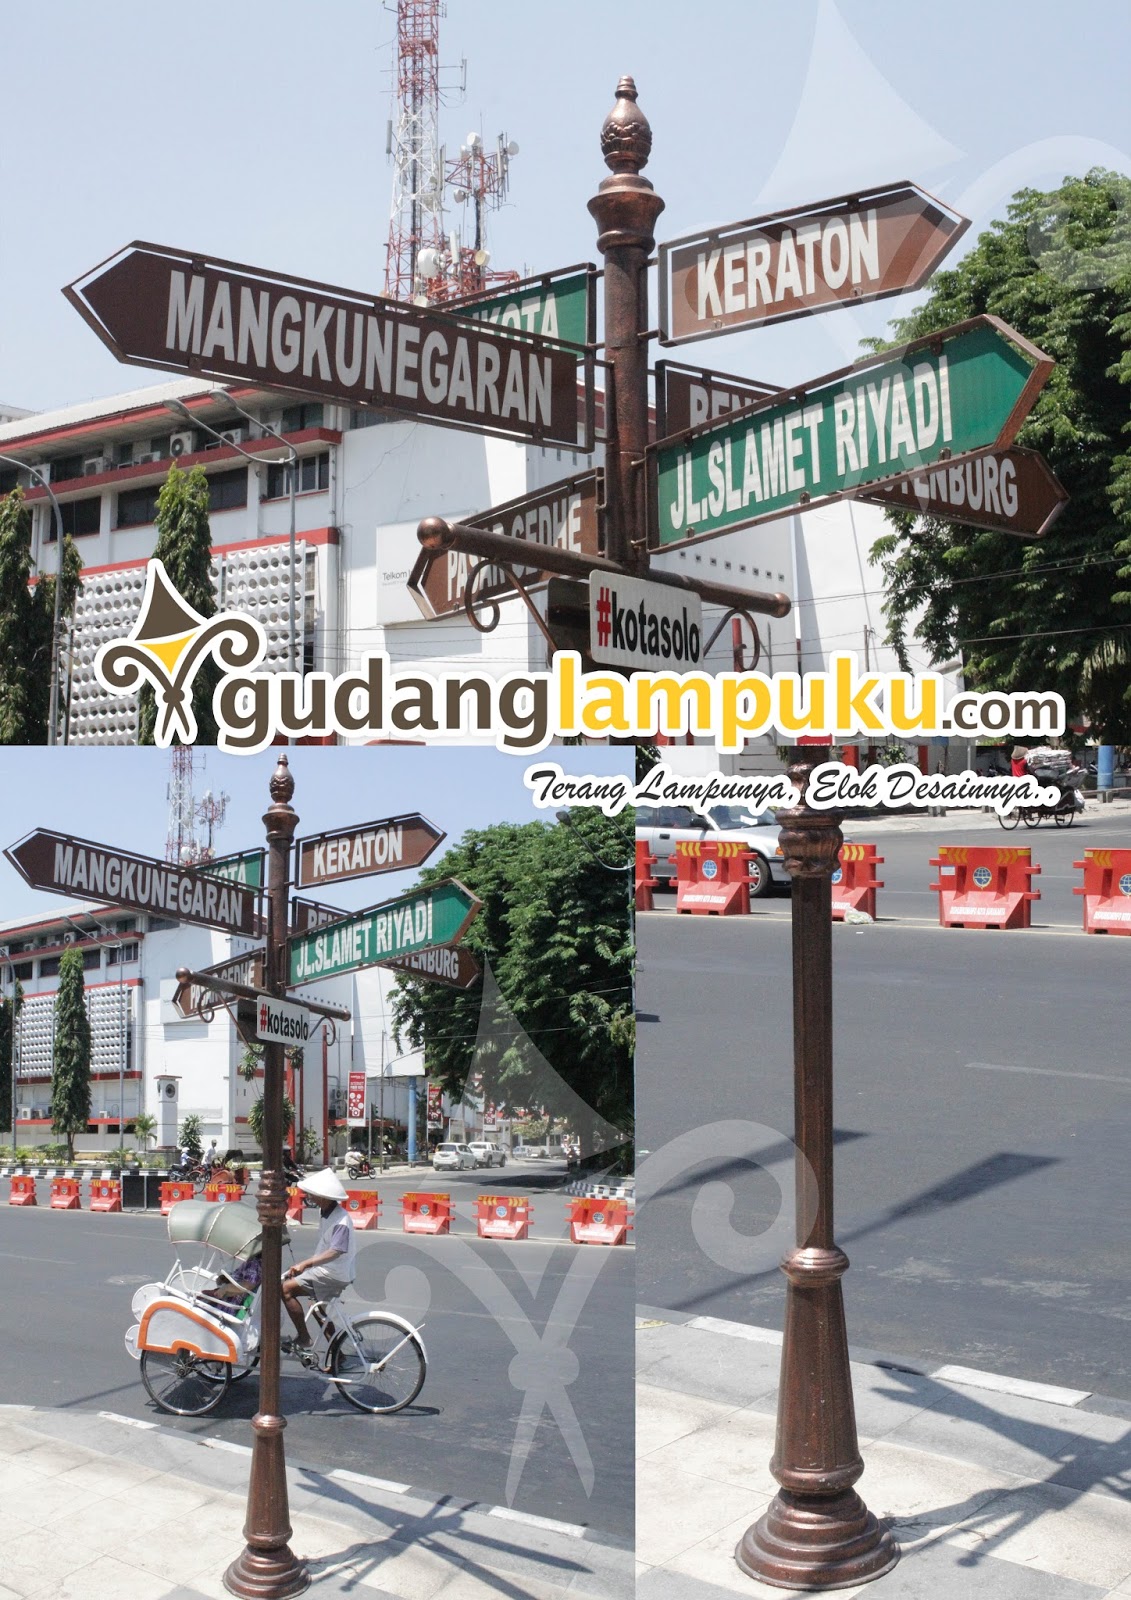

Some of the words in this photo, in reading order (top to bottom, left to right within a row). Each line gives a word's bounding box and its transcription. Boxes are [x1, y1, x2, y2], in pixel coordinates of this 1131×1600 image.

[697, 209, 880, 320] KERATON
[165, 270, 552, 427] MANGKUNEGARAN
[471, 292, 560, 350] OTA
[670, 407, 824, 531] JL.SLAMET
[834, 354, 953, 476] RIYADI
[382, 571, 408, 581] Telkom
[596, 586, 700, 661] #kotasolo
[53, 842, 243, 927] MANGKUNEGARAN
[313, 825, 403, 878] KERATON
[296, 918, 371, 977] JL.SLAMET
[376, 897, 433, 954] RIYADI
[260, 1003, 309, 1041] #kotasolo
